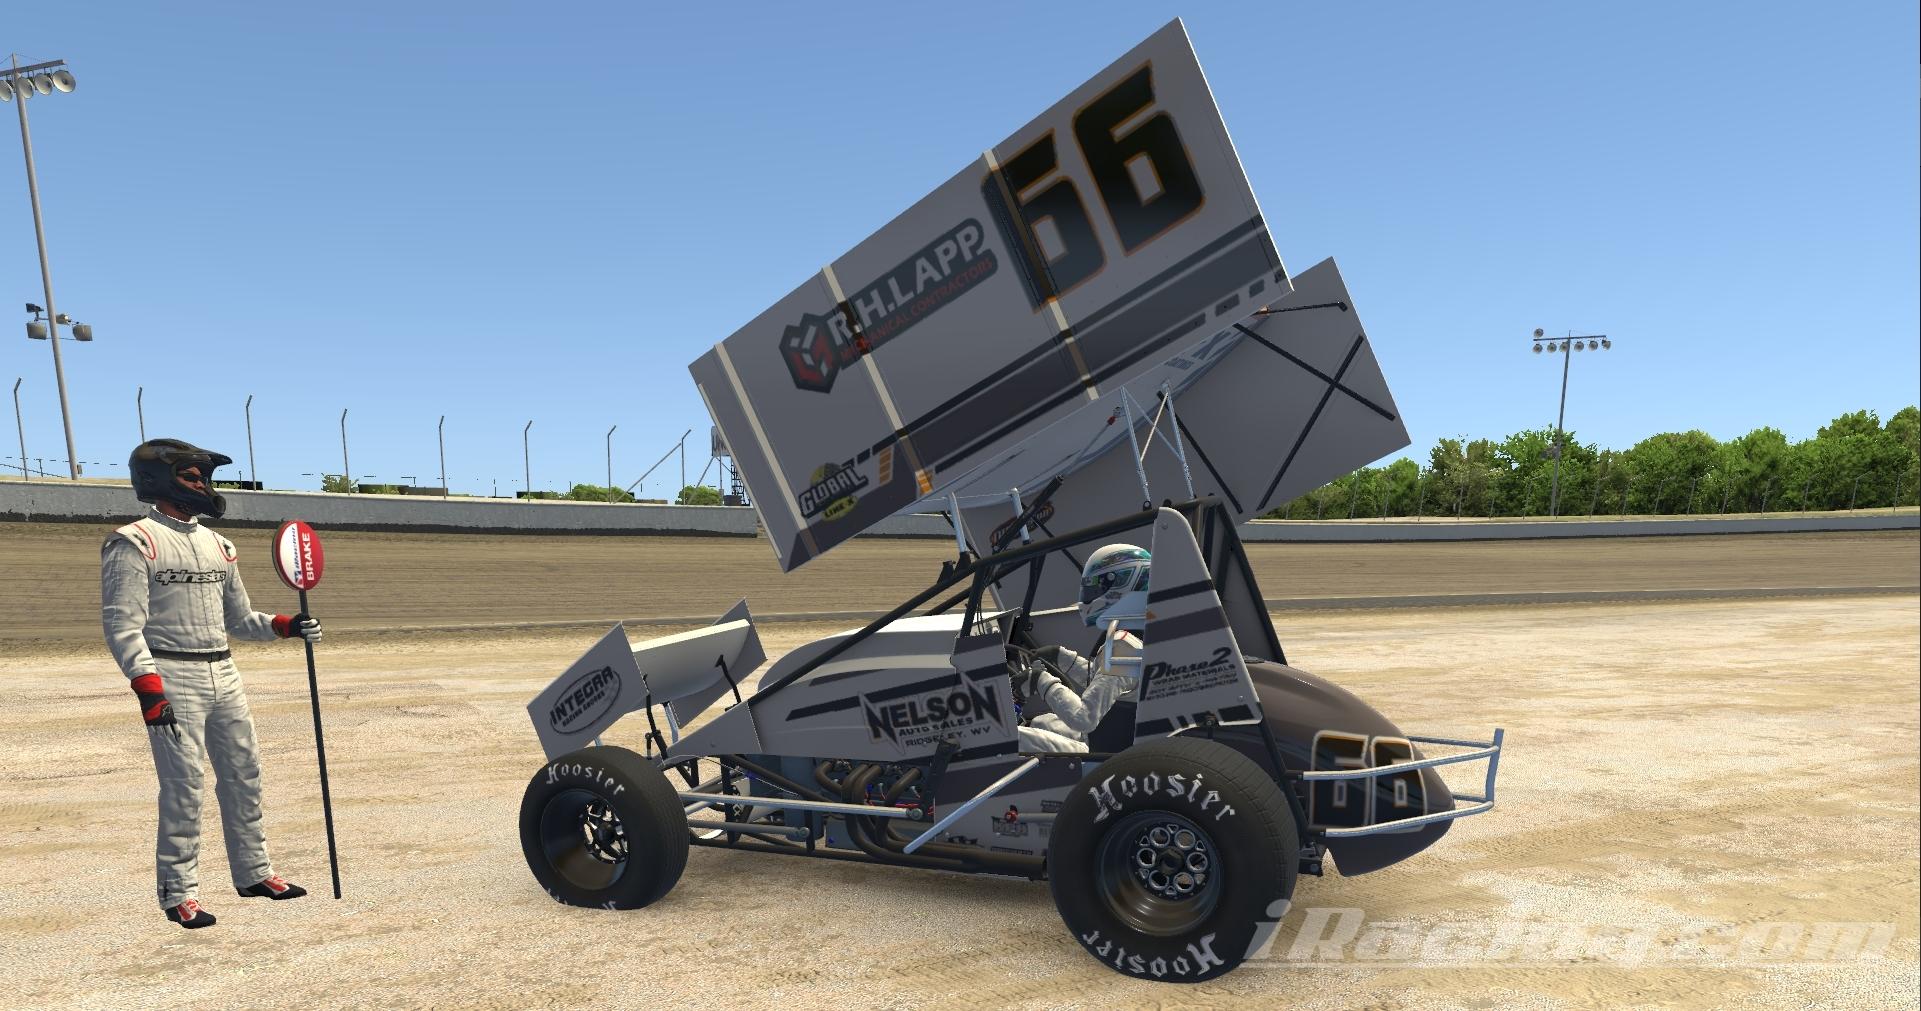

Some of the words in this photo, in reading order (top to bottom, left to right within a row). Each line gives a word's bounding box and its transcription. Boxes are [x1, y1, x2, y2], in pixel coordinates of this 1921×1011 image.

[980, 58, 1206, 315] 66
[799, 465, 869, 518] GLOBAL
[302, 532, 315, 581] BRAKE
[549, 666, 614, 725] INTEGRA
[863, 681, 1005, 747] NELSON
[899, 726, 930, 737] AUTO
[932, 717, 974, 731] SALES
[970, 725, 991, 736] WV
[546, 763, 625, 795] Hoosier
[1088, 771, 1236, 824] Hoosier
[1082, 931, 1225, 978] Hoosier
